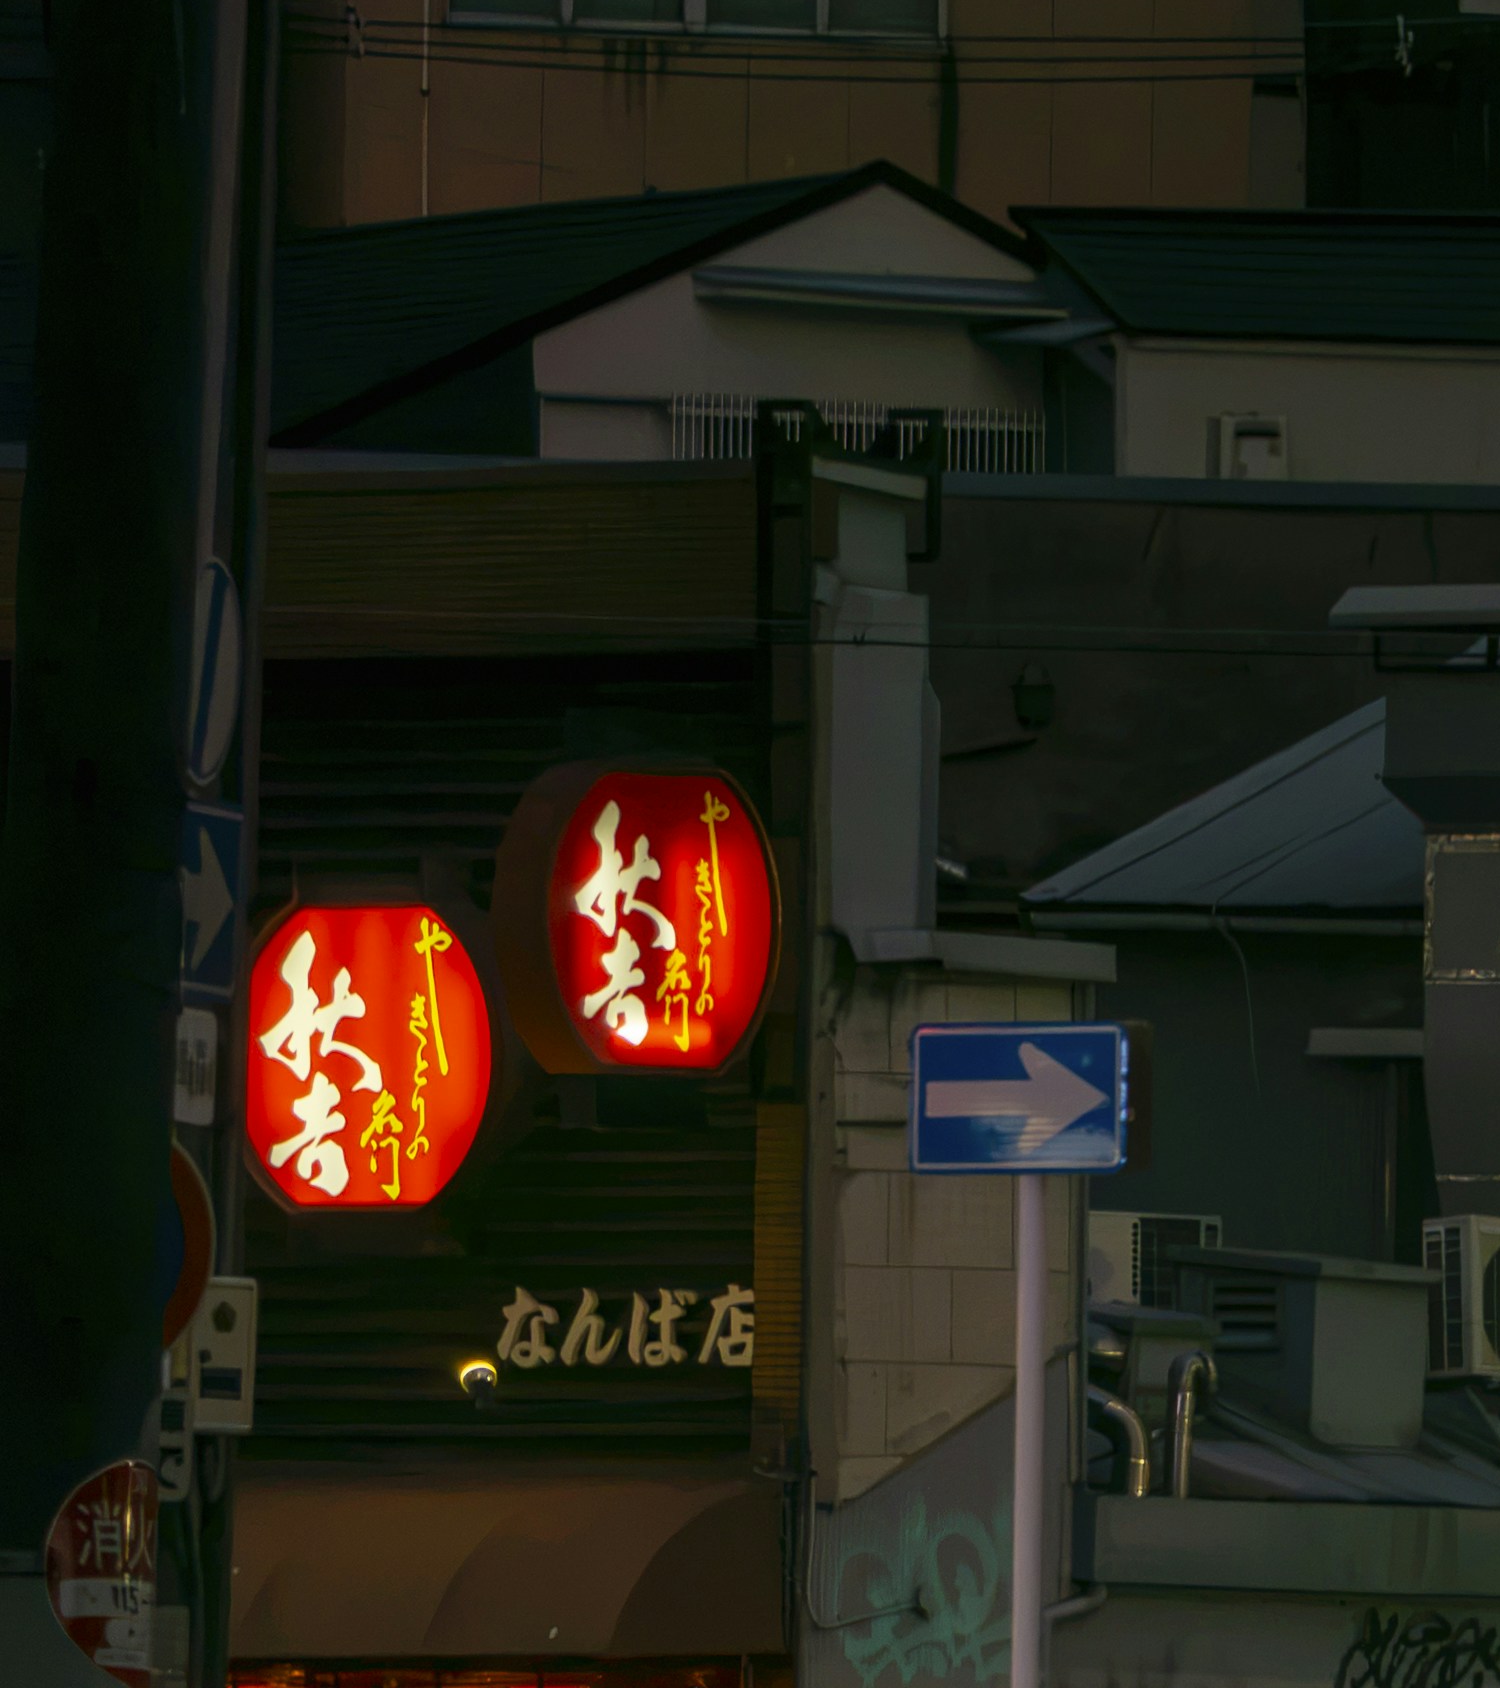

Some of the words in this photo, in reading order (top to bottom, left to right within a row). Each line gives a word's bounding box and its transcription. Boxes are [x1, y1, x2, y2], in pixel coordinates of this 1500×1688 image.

[574, 799, 676, 1046] 秋吉
[258, 929, 383, 1198] 秋吉
[497, 1283, 754, 1369] なんば店
